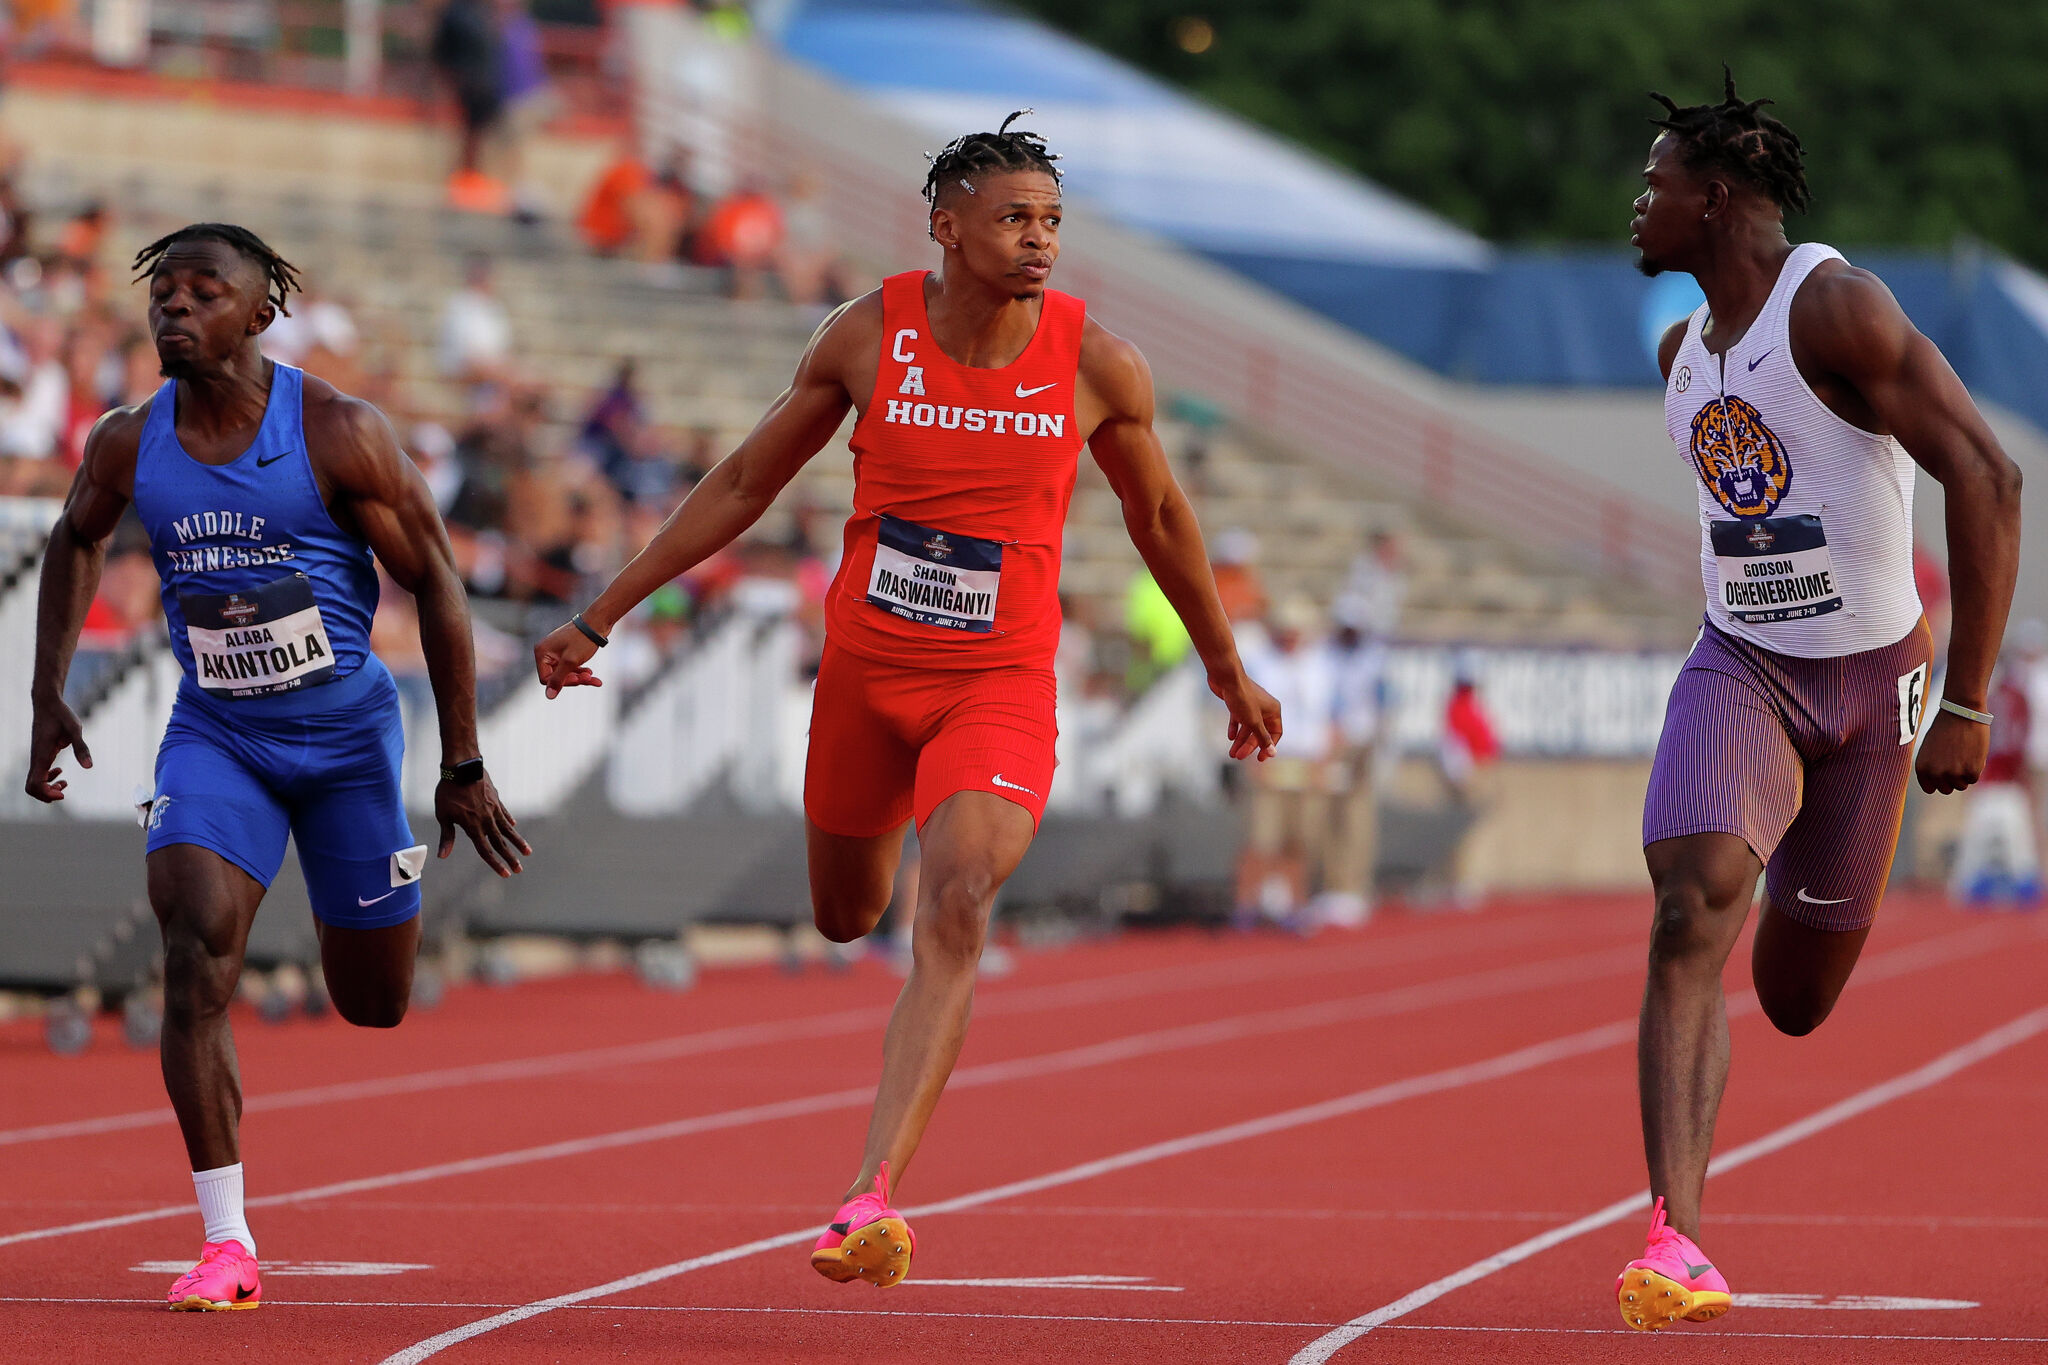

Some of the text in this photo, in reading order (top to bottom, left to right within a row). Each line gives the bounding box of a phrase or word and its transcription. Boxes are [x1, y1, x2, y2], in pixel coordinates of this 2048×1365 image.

[892, 328, 918, 363] C
[898, 366, 926, 396] A
[884, 399, 1065, 438] HOUSTON
[172, 510, 265, 544] MIDDLE
[167, 543, 295, 572] TENNESSEE
[1743, 559, 1794, 577] GODSON
[912, 563, 957, 586] SHAUN
[1725, 571, 1834, 606] OGHENEBRUME
[876, 568, 991, 616] MASWANGANYI
[915, 613, 925, 621] TX
[935, 617, 953, 627] JUNE
[953, 620, 967, 629] 7-10
[1767, 612, 1775, 620] TX
[1786, 609, 1802, 618] JUNE
[1803, 607, 1817, 616] 7-10
[225, 627, 274, 648] ALABA
[201, 633, 326, 681] AKINTOLA
[288, 678, 301, 688] 7-10
[1908, 670, 1921, 736] 6
